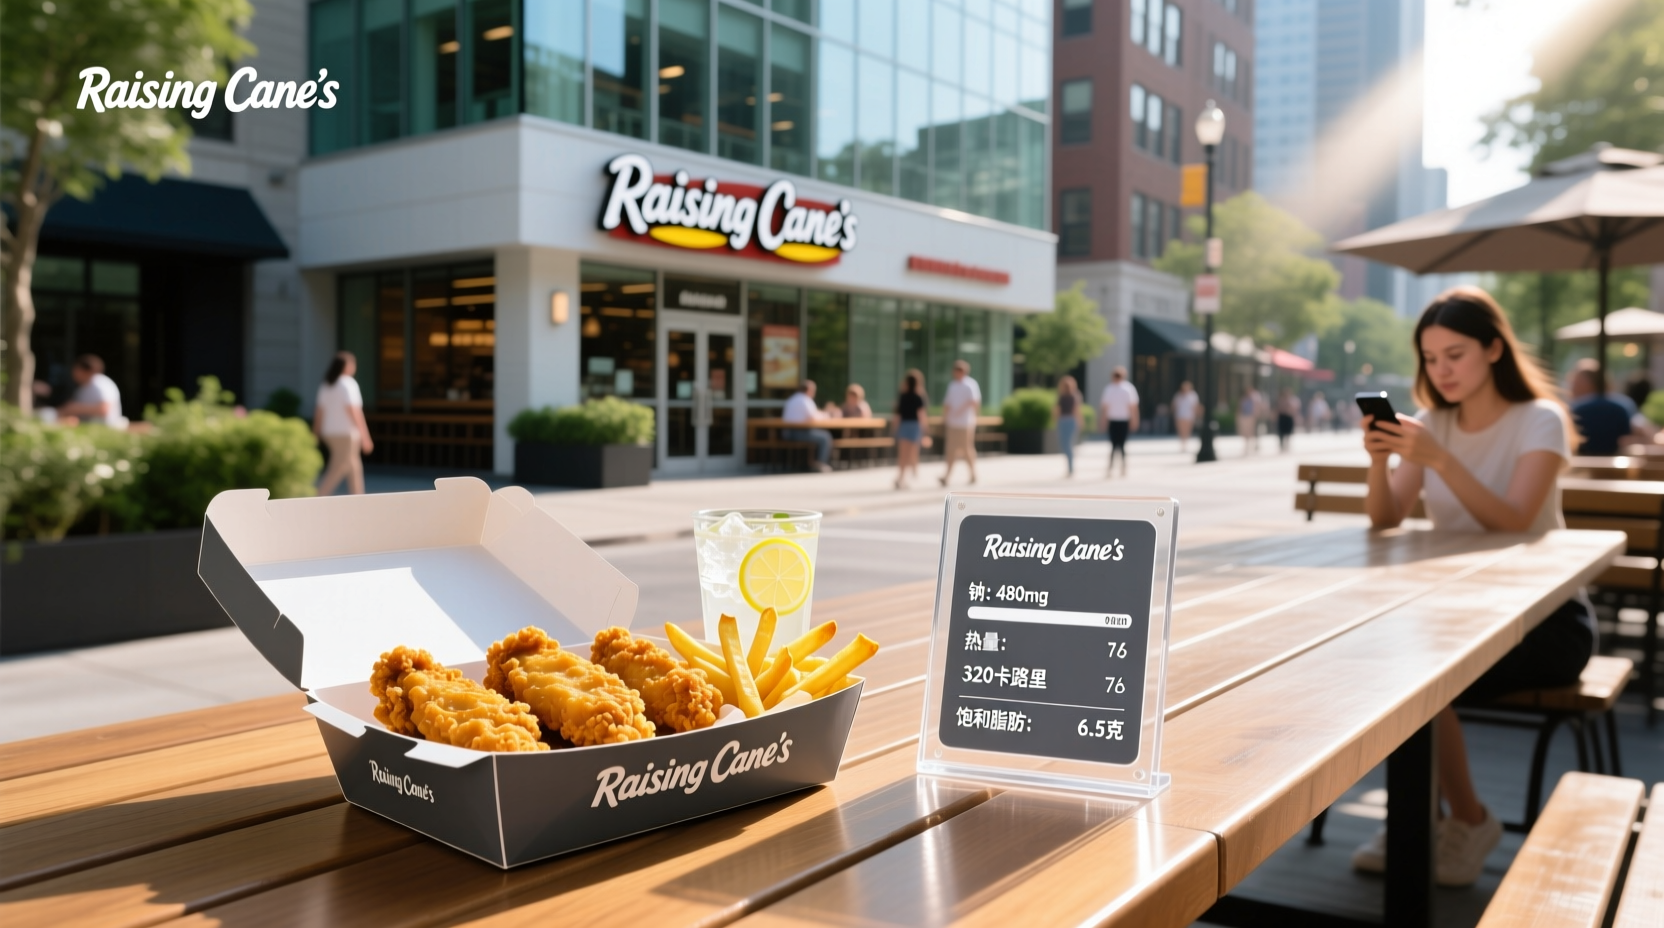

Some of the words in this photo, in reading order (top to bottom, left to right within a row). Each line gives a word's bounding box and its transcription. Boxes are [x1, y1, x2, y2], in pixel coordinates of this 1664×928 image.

[602, 153, 759, 250] Raising
[757, 179, 859, 251] Cane's
[983, 533, 1057, 565] Raising
[1059, 535, 1125, 563] Cane's
[995, 585, 1049, 607] 480mg
[1107, 642, 1128, 659] 76
[961, 665, 1048, 689] 320卡路里
[1105, 677, 1126, 694] 76
[1077, 718, 1125, 741] 6.5克
[590, 758, 709, 808] Raising
[710, 731, 793, 784] Cane's
